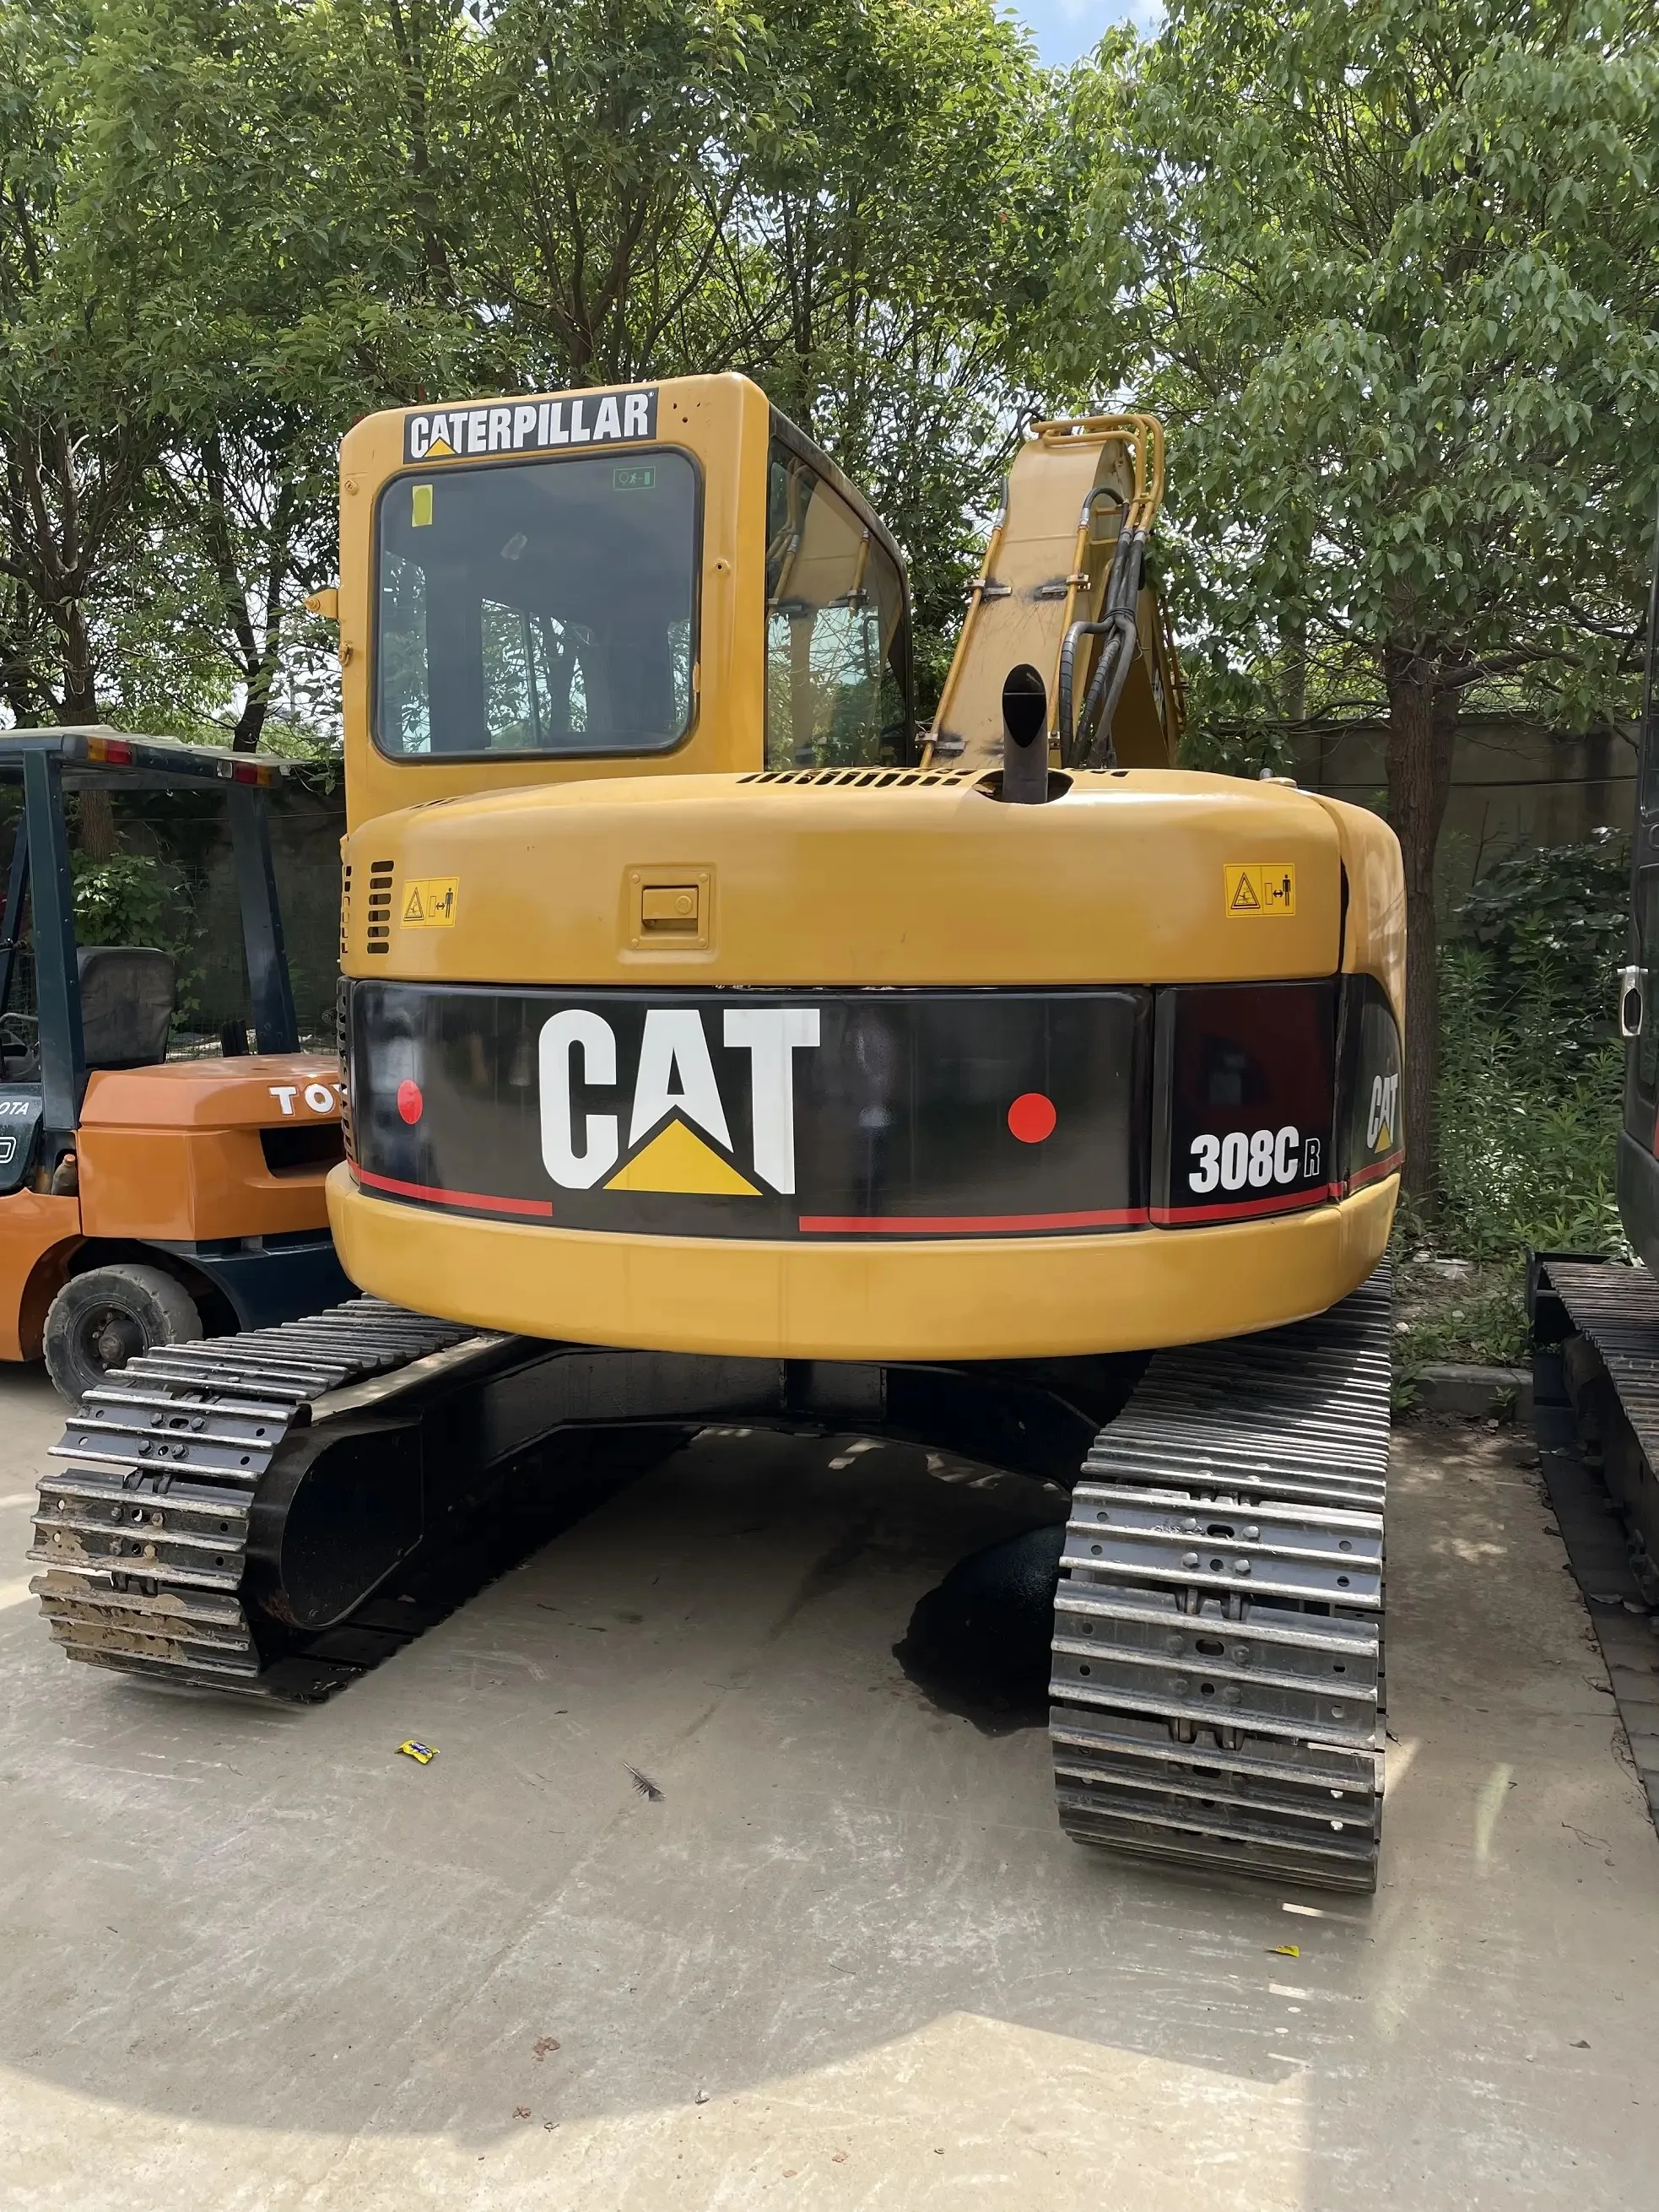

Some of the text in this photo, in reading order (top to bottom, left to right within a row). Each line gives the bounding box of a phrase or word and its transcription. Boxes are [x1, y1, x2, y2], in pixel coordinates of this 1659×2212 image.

[410, 393, 649, 458] CATERPILLAR
[268, 1083, 342, 1115] TO
[539, 1009, 820, 1194] CAT
[1367, 1074, 1398, 1149] CAT
